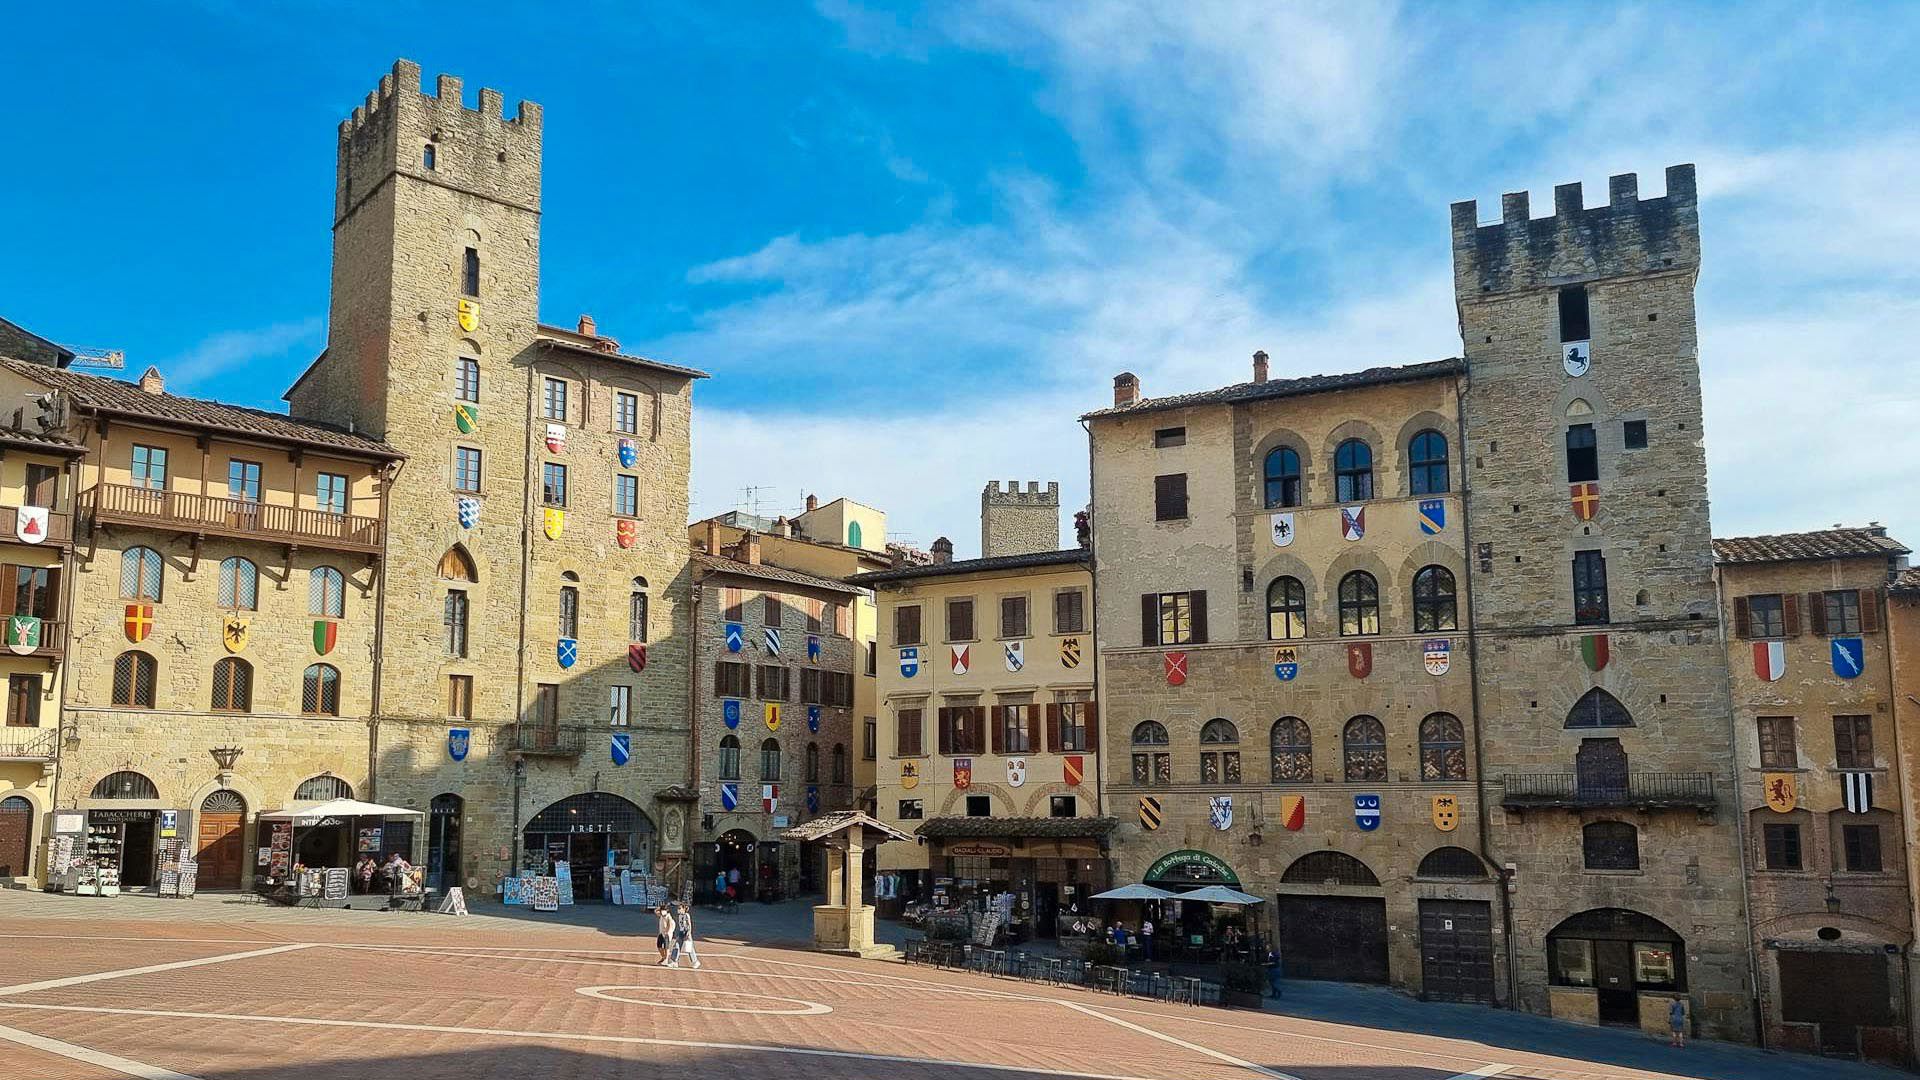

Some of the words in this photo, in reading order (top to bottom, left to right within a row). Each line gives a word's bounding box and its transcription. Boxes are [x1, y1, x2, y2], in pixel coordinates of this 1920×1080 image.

[94, 811, 152, 819] TABACCHERIA
[1153, 865, 1164, 875] La
[1162, 855, 1191, 868] Bottega
